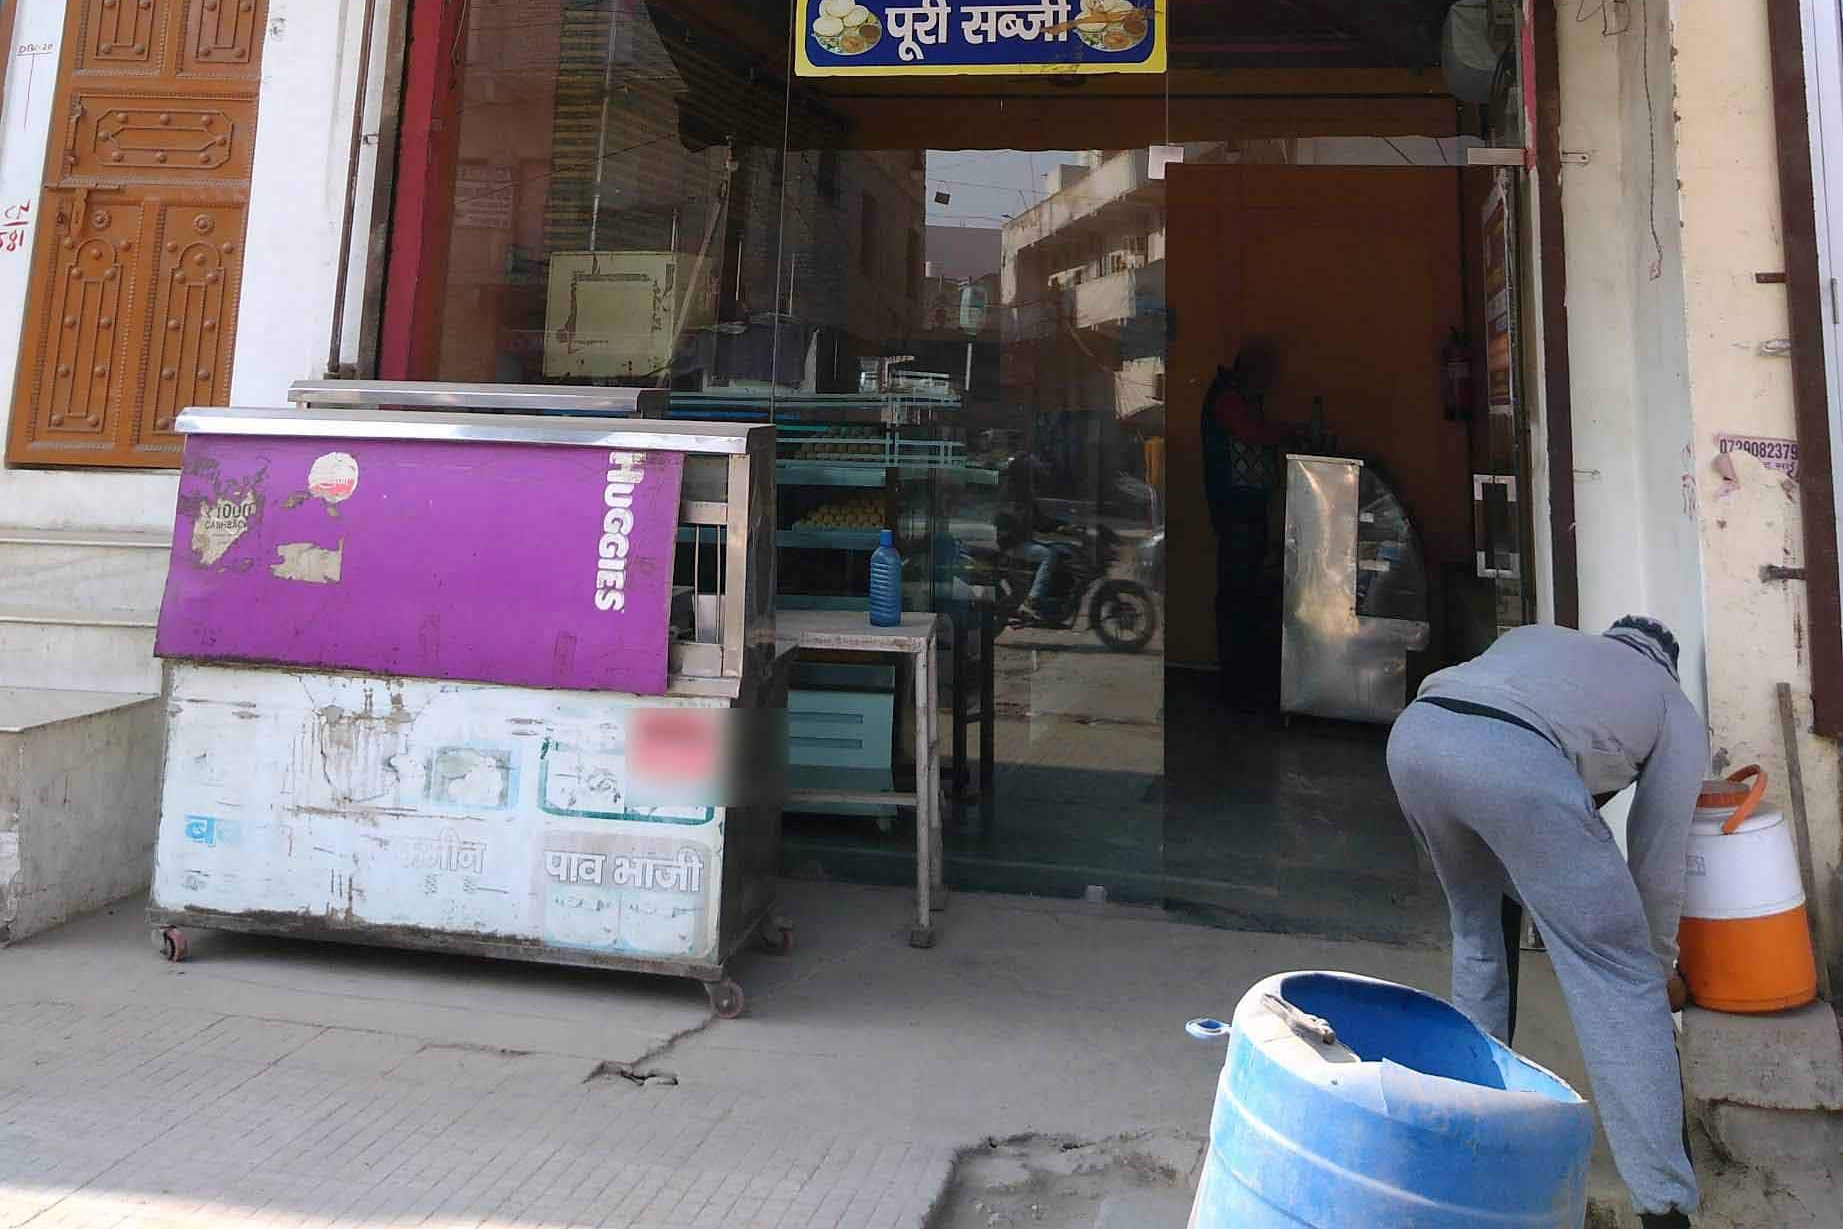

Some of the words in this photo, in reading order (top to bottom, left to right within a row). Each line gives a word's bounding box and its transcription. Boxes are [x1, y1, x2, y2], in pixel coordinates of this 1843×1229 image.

[594, 451, 647, 612] HUGGIES
[544, 849, 607, 885] पाव
[613, 845, 704, 892] भाजी
